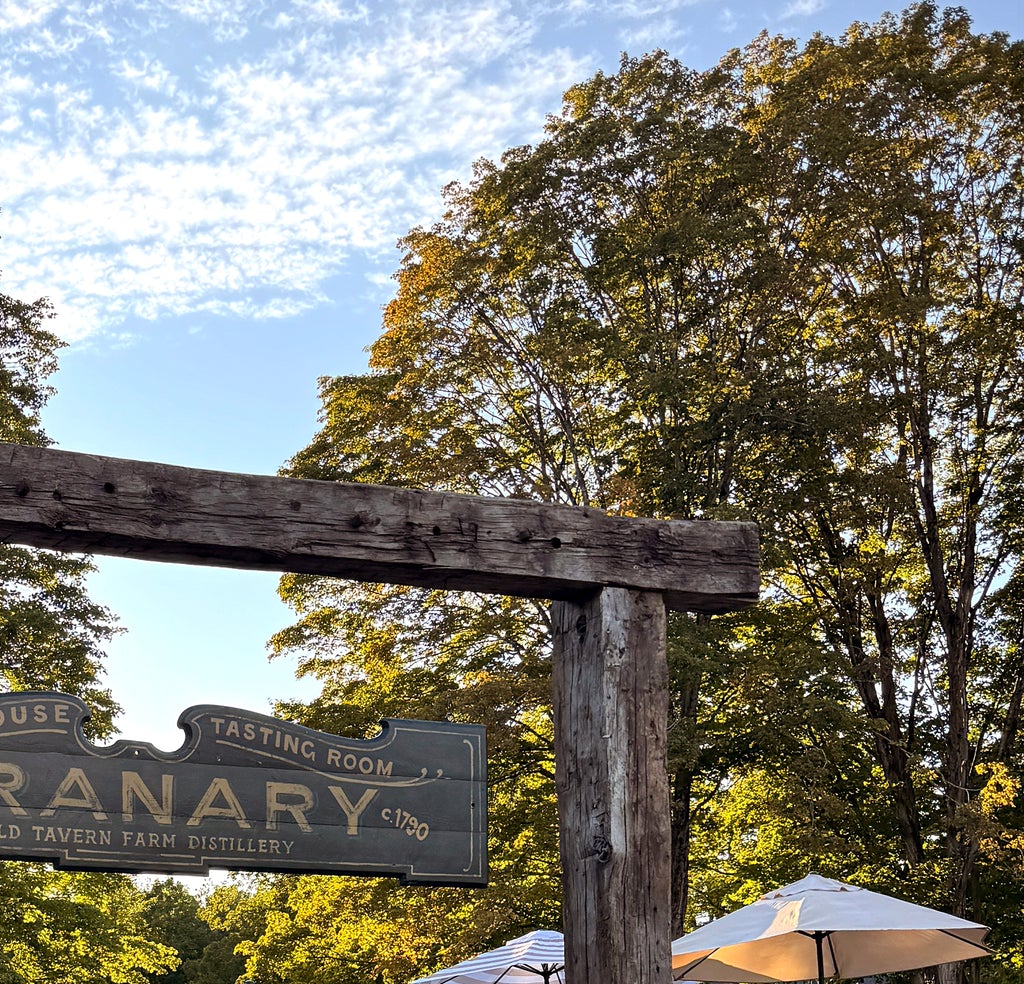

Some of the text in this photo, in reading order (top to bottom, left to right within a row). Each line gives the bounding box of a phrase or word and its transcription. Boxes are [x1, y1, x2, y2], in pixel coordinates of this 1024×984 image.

[210, 717, 394, 777] TASTING ROOM
[32, 825, 112, 846] TAVERN
[122, 831, 176, 849] FARM
[188, 835, 294, 855] DISTILLERY
[381, 808, 429, 841] c.1790
